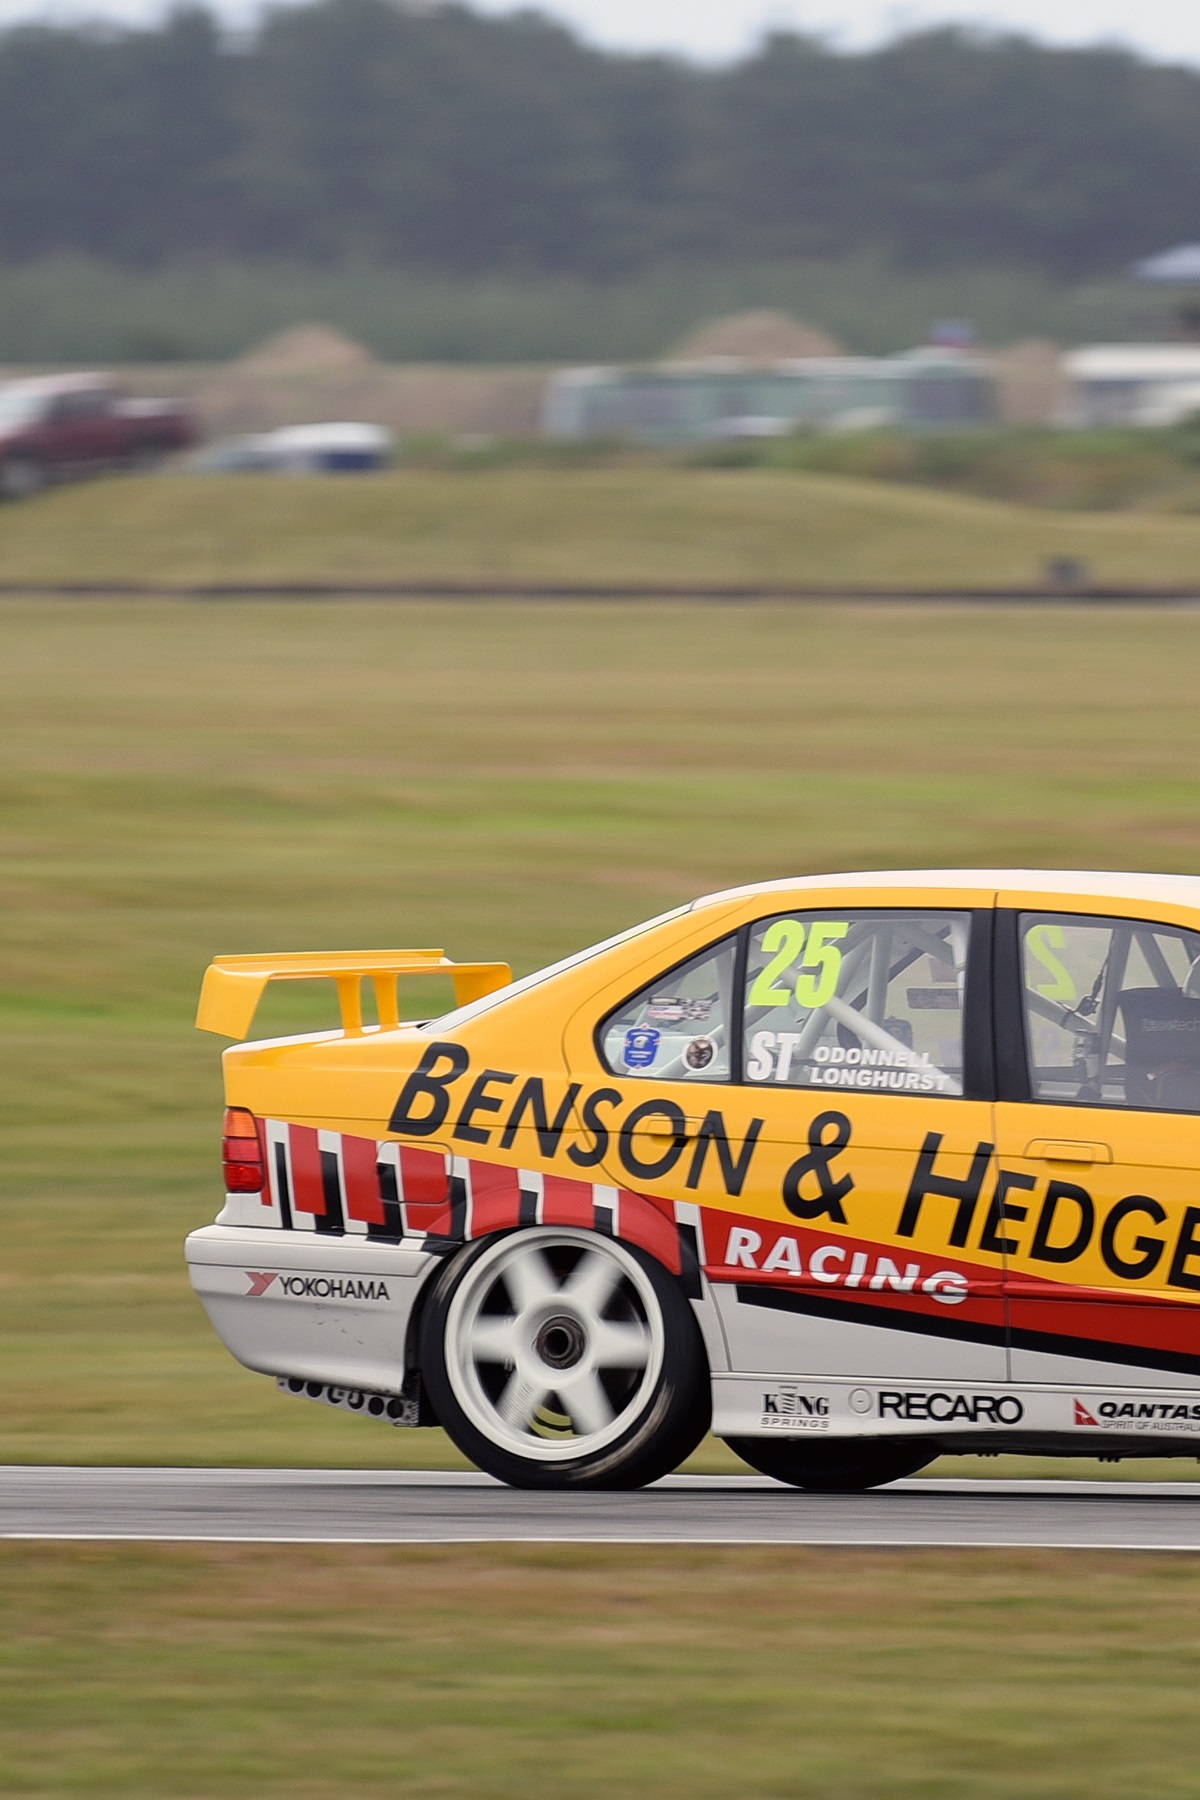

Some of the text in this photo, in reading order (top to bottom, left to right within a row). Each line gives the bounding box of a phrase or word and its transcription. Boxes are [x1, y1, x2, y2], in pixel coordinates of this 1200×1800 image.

[748, 919, 850, 1008] 25
[747, 1030, 801, 1081] ST
[813, 1046, 935, 1069] ODONNELL
[810, 1067, 951, 1091] LONGHURST
[387, 1041, 764, 1197] BENSON
[782, 1110, 855, 1224] &
[724, 1227, 969, 1304] RACING
[279, 1276, 391, 1301] YOKOHAMA
[878, 1391, 1024, 1425] RECARO
[760, 1417, 830, 1429] SPRINGS
[1100, 1419, 1133, 1429] SPIRIT
[1135, 1421, 1149, 1430] OF
